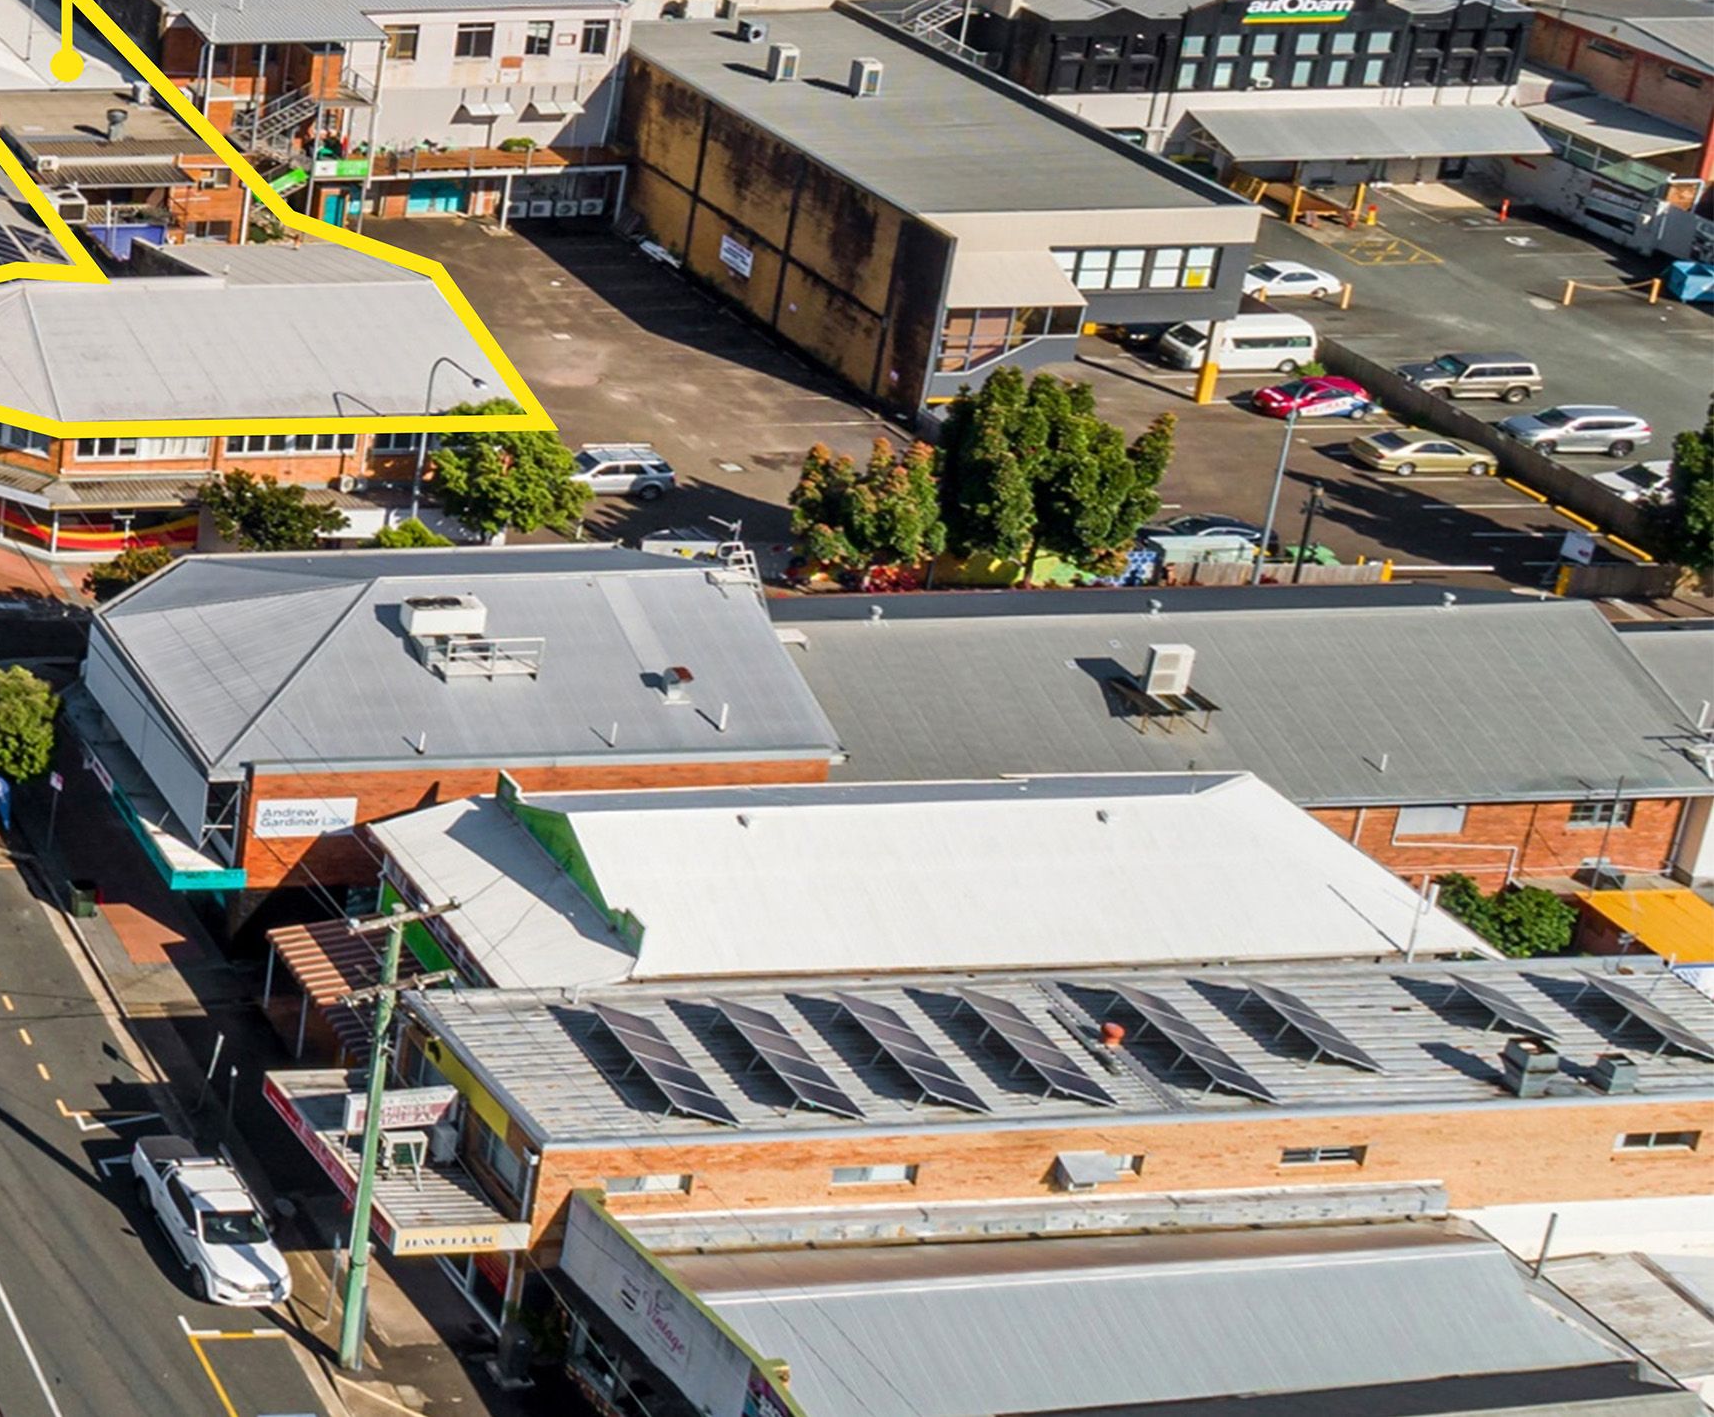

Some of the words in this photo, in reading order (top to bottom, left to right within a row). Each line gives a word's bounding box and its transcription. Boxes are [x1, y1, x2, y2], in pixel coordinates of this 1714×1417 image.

[262, 808, 318, 818] Andrew
[260, 817, 320, 828] Gardiner
[322, 817, 350, 827] Law
